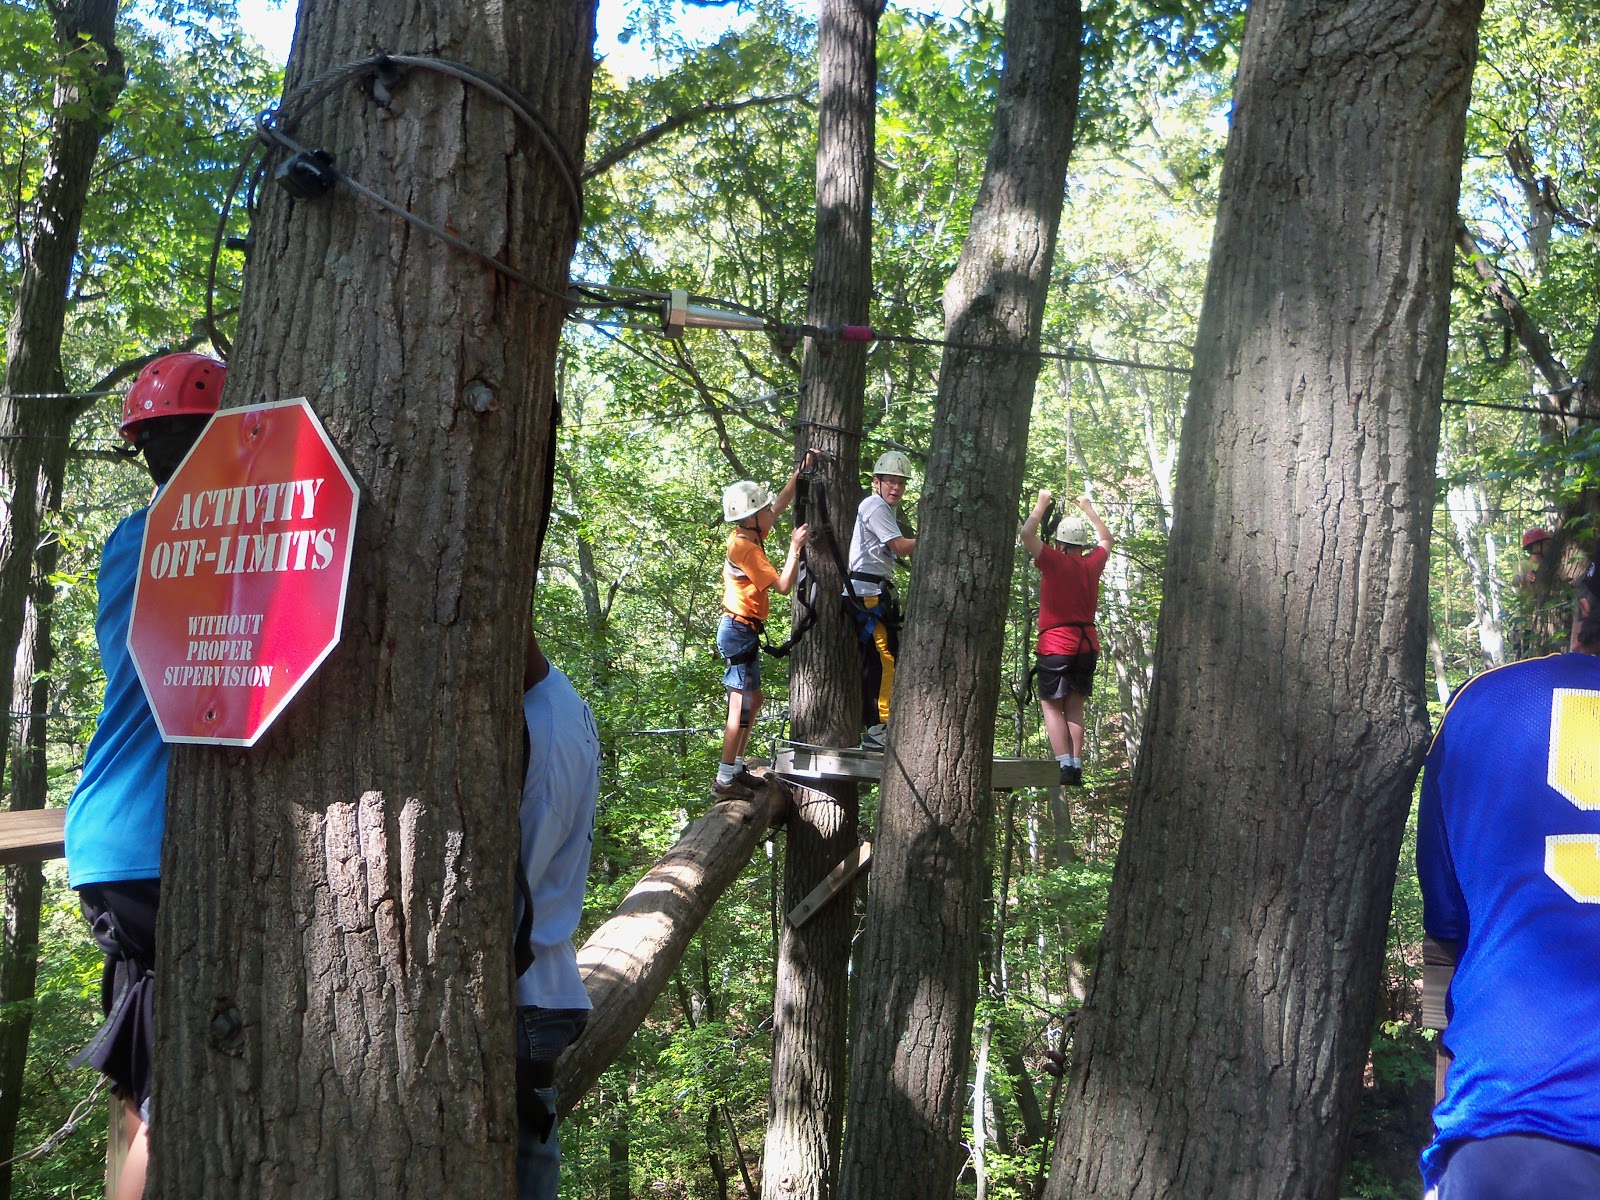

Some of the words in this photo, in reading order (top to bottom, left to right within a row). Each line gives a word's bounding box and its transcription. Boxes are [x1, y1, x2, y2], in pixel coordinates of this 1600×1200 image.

[172, 479, 324, 531] ACTIVITY
[150, 528, 336, 580] OFF-LIMITS
[188, 614, 264, 636] WITHOUT
[186, 640, 252, 661] PROPER
[163, 665, 273, 687] SUPERVISION
